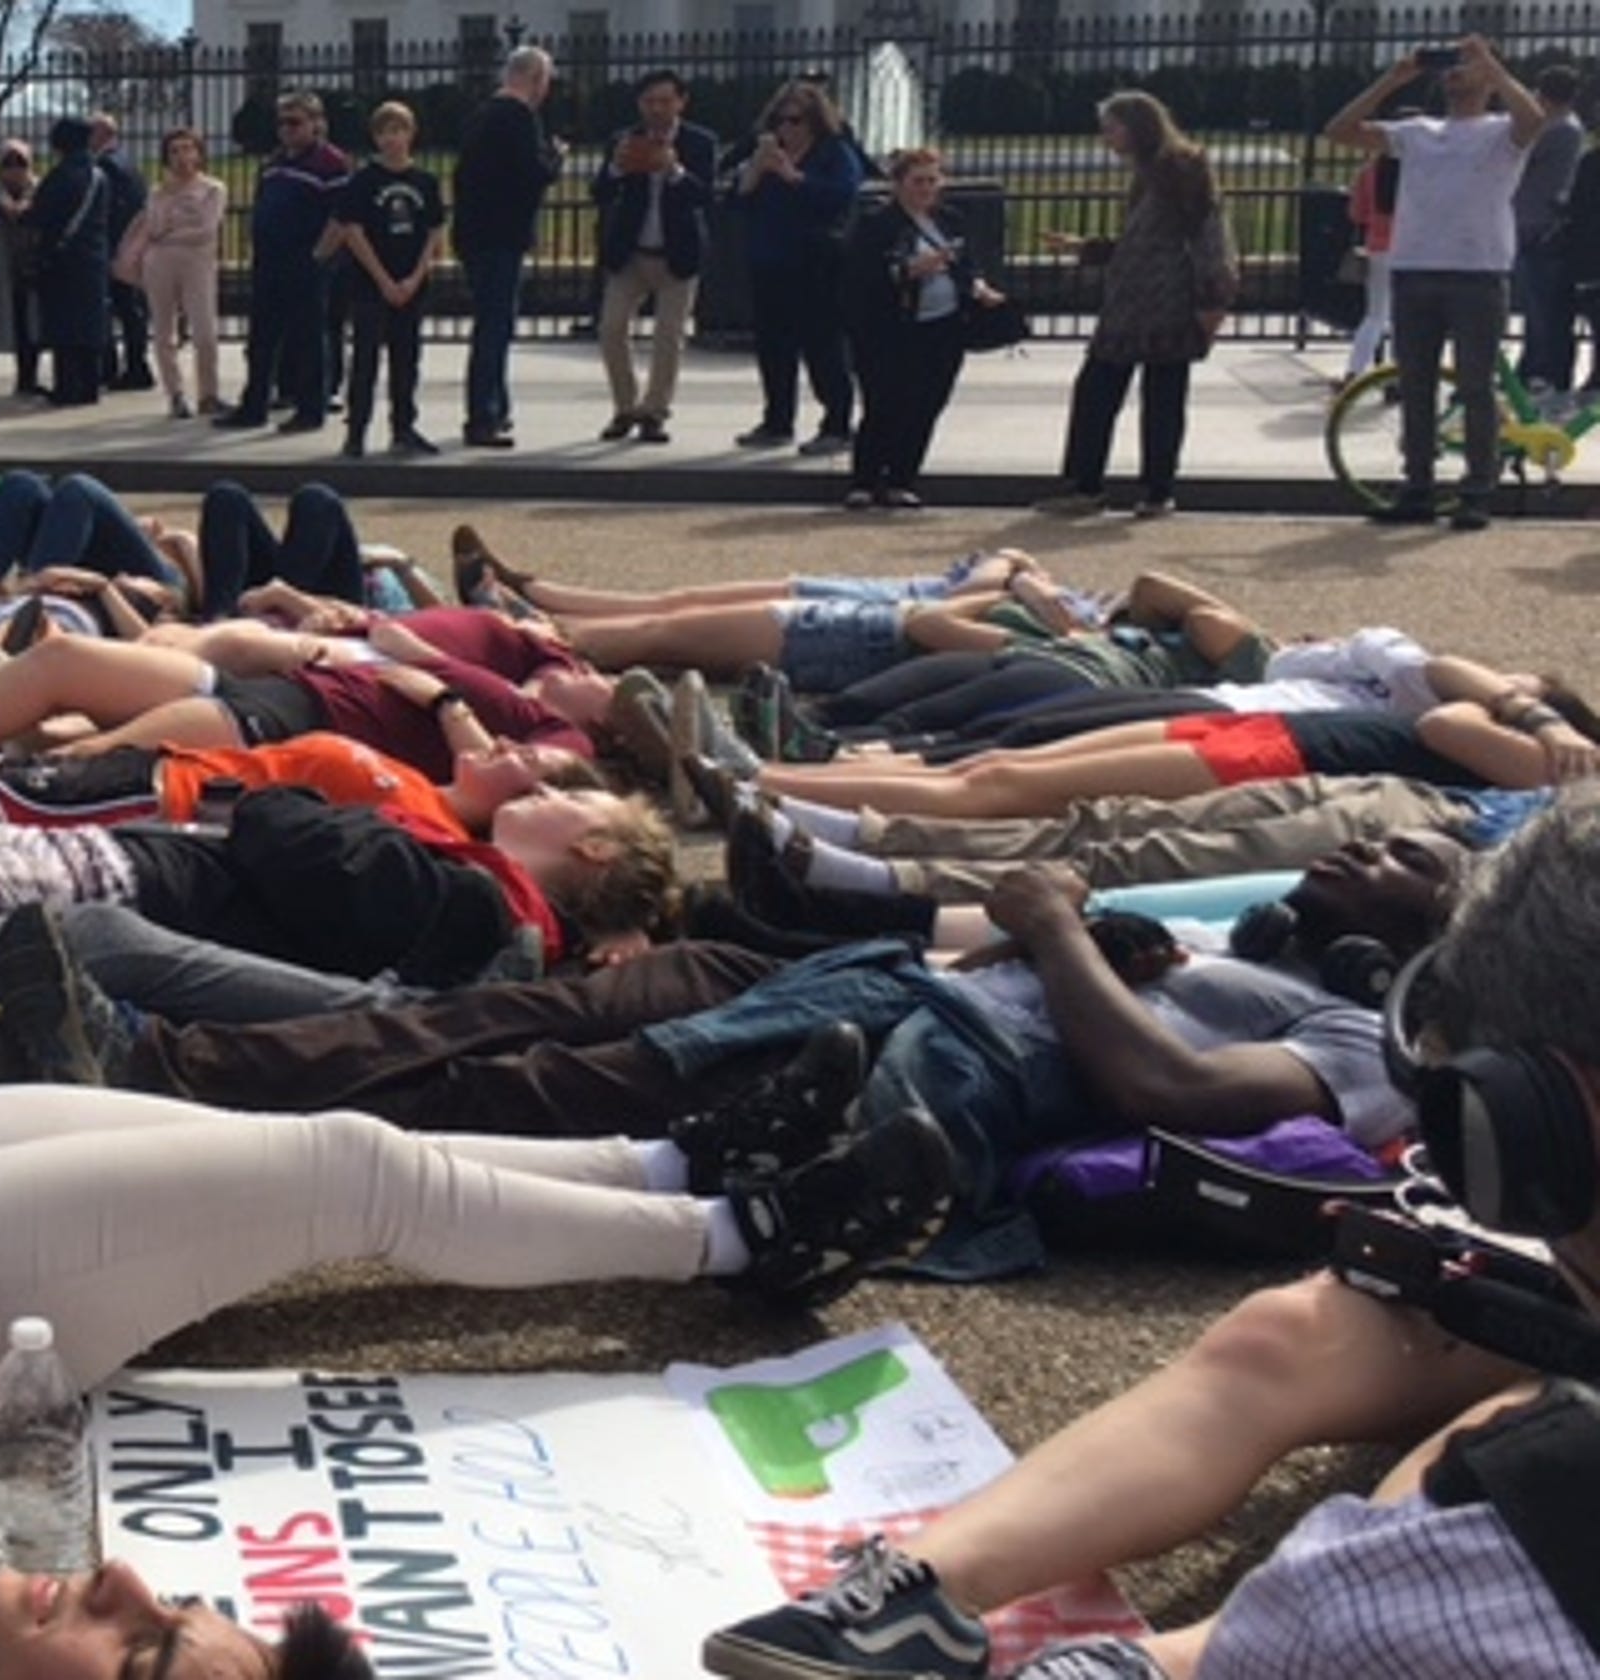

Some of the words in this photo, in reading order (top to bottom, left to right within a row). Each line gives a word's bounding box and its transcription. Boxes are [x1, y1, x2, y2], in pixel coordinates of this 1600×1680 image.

[107, 1389, 223, 1541] ONLY
[213, 1426, 315, 1471] I
[441, 1405, 572, 1511] HOLD
[235, 1511, 376, 1648] UNS
